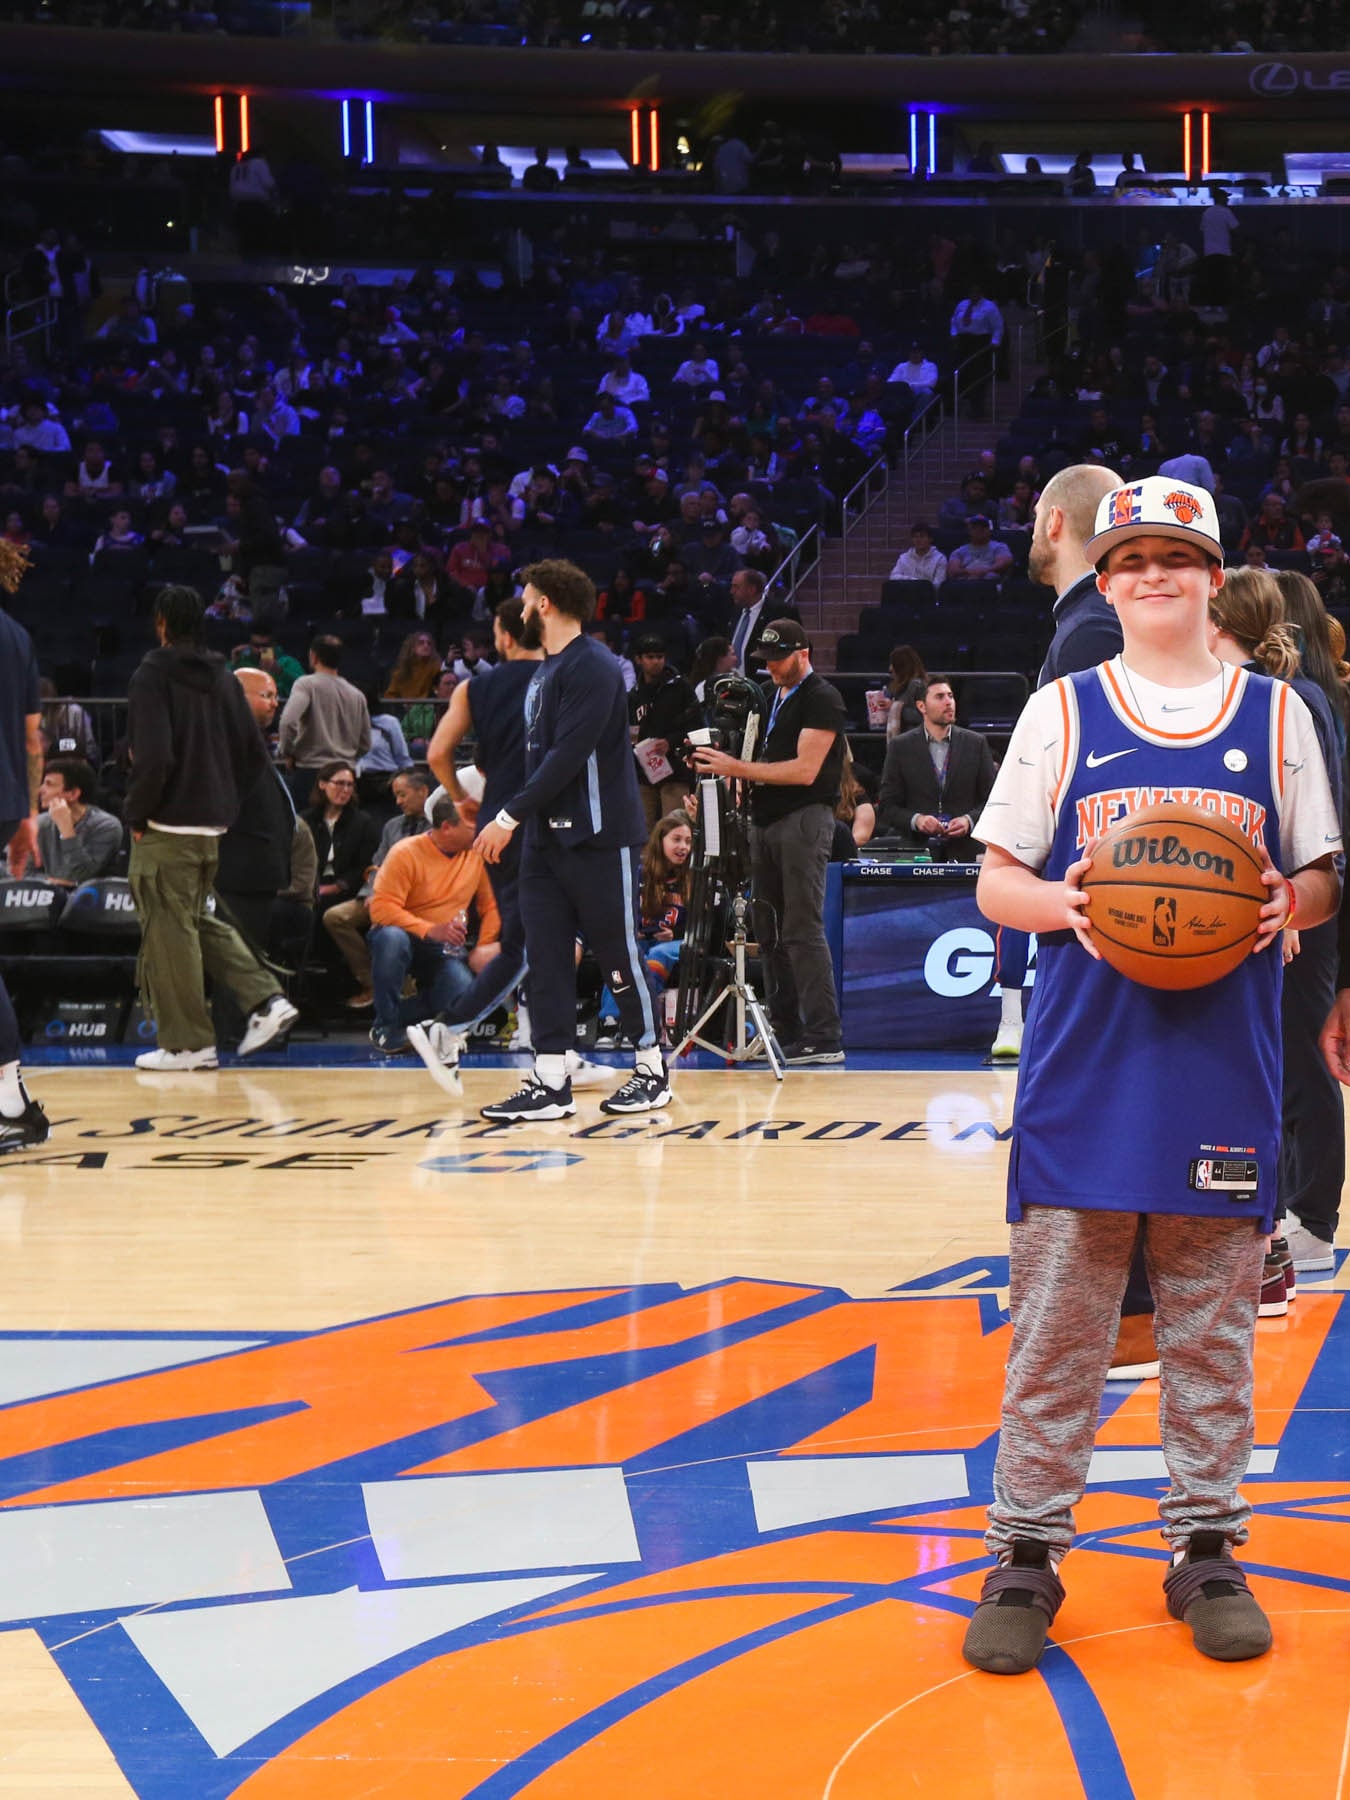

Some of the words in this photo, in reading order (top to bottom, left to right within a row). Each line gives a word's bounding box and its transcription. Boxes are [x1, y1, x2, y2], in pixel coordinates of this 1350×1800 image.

[1113, 835, 1235, 883] Wilson
[860, 867, 892, 875] CHASE
[912, 867, 945, 876] CHASE
[5, 889, 55, 907] HUB
[105, 892, 135, 911] HU
[69, 1022, 107, 1037] HUB
[568, 1119, 1012, 1141] GARDEN
